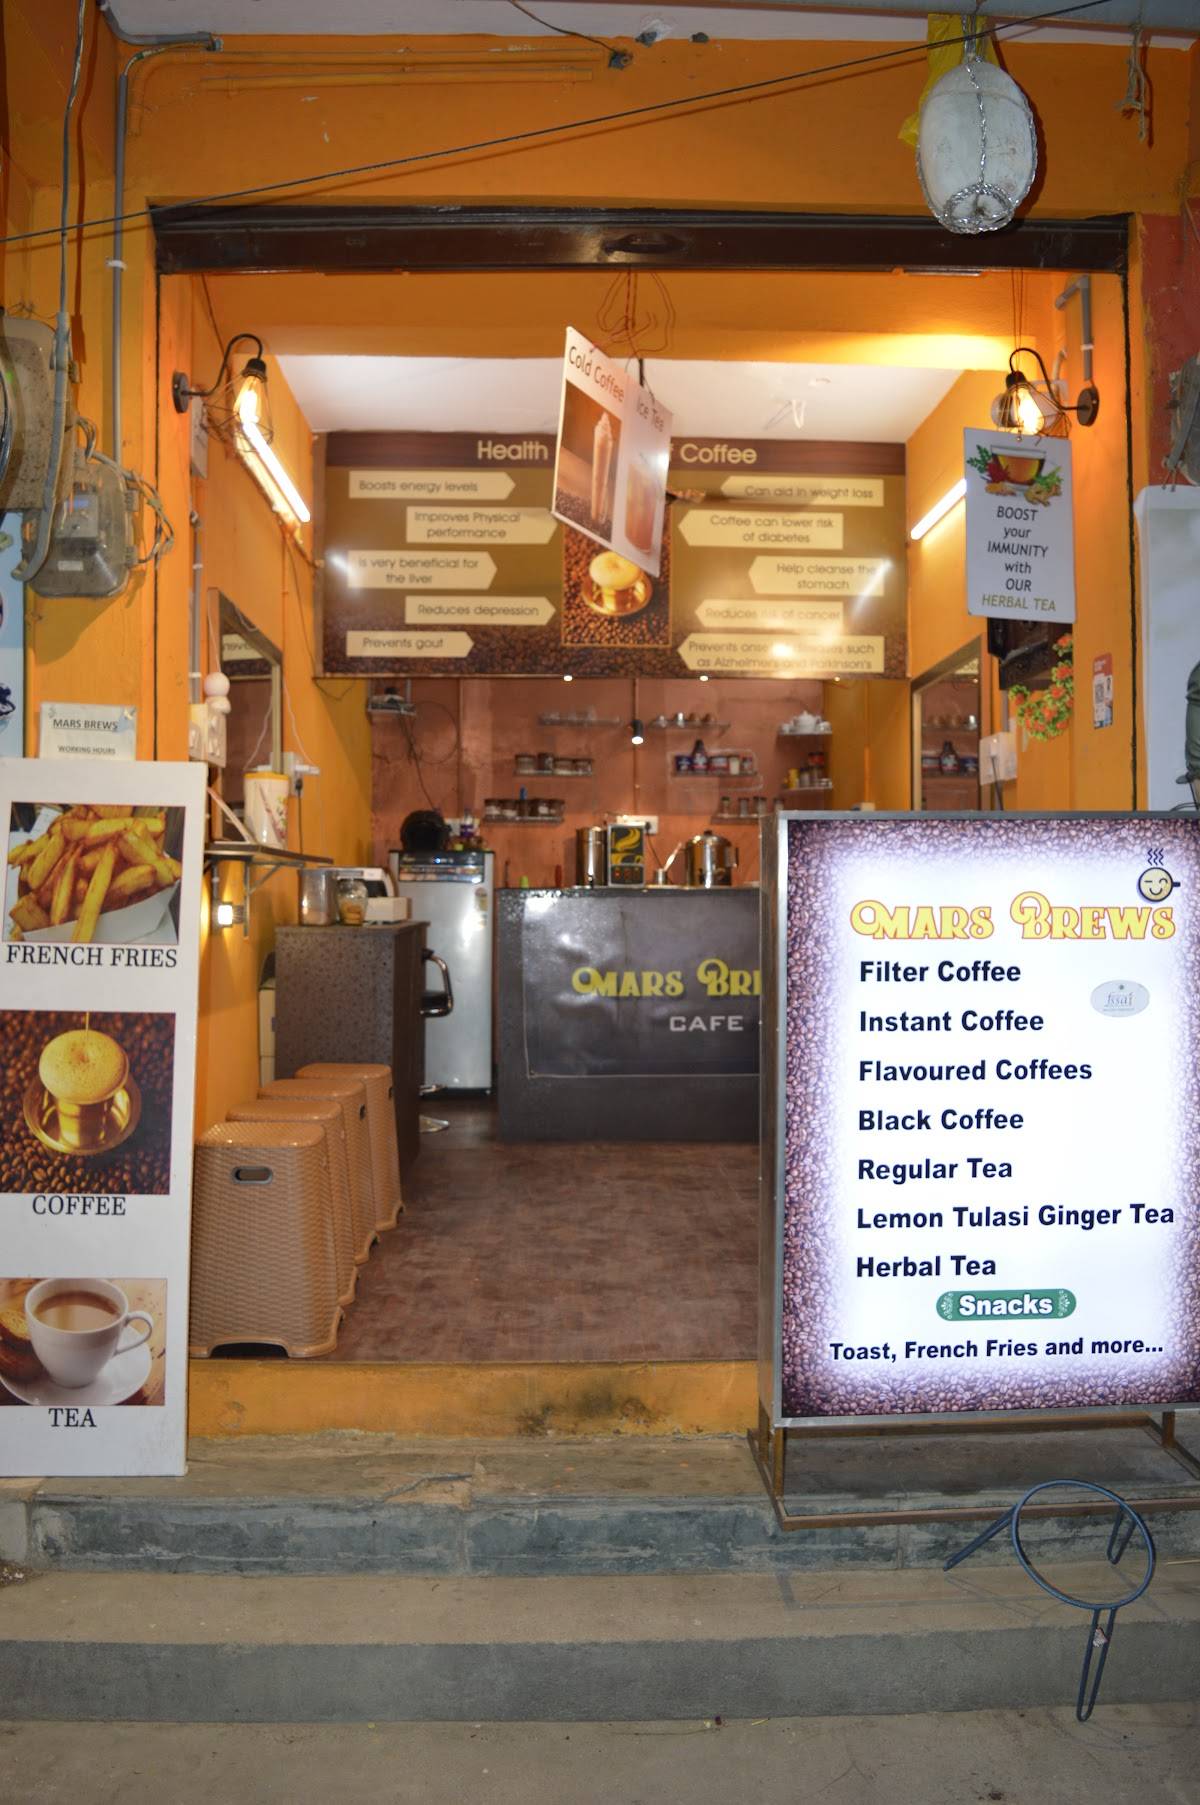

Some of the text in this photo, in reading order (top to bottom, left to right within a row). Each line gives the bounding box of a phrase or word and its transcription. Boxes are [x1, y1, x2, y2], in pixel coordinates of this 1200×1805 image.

[569, 345, 625, 403] Cold Coffee
[477, 440, 549, 460] Health
[680, 443, 758, 464] Coffee
[358, 480, 478, 494] Boosts energy levels
[745, 485, 874, 500] Can aid in weight loss
[414, 511, 521, 525] Improves Physical
[996, 505, 1039, 522] BOOST
[710, 515, 834, 529] Coffee can lower risk
[426, 527, 507, 539] performance
[742, 531, 810, 544] of diabetes
[1002, 526, 1031, 540] your
[987, 540, 1049, 558] IMMUNITY
[370, 559, 397, 571] very
[399, 557, 460, 569] beneficial
[462, 557, 479, 569] for
[776, 563, 804, 576] Help
[806, 562, 855, 576] cleanse
[1004, 561, 1032, 574] with
[385, 573, 433, 585] the liver
[797, 578, 850, 591] stomach
[1005, 577, 1032, 592] OUR
[982, 593, 1056, 612] HERBAL TEA
[417, 603, 541, 619] Reduces depression
[704, 606, 757, 620] Reduces
[798, 608, 841, 621] cancer
[362, 637, 444, 652] Prevents gout
[688, 640, 739, 653] Prevents
[845, 643, 875, 656] such
[697, 658, 711, 669] as
[53, 718, 118, 731] MARS BREWS
[58, 744, 116, 756] WORKING HOURS
[1010, 890, 1176, 940] BREWS
[6, 944, 177, 968] FRENCH FRIES
[860, 960, 1021, 982] Filter Coffee
[669, 1015, 744, 1031] CAFE
[860, 1010, 1044, 1032] Instant Coffee
[859, 1059, 1092, 1081] Flavoured Coffees
[859, 1108, 1024, 1131] Black Coffee
[858, 1157, 1012, 1185] Regular Tea
[32, 1195, 127, 1216] COFFEE
[857, 1203, 1174, 1231] Lemon Tulasi Ginger Tea
[857, 1255, 996, 1278] Herbal Tea
[958, 1294, 1053, 1317] Snacks
[829, 1337, 1163, 1363] Toast, French Fries and more...
[48, 1407, 97, 1428] TEA
